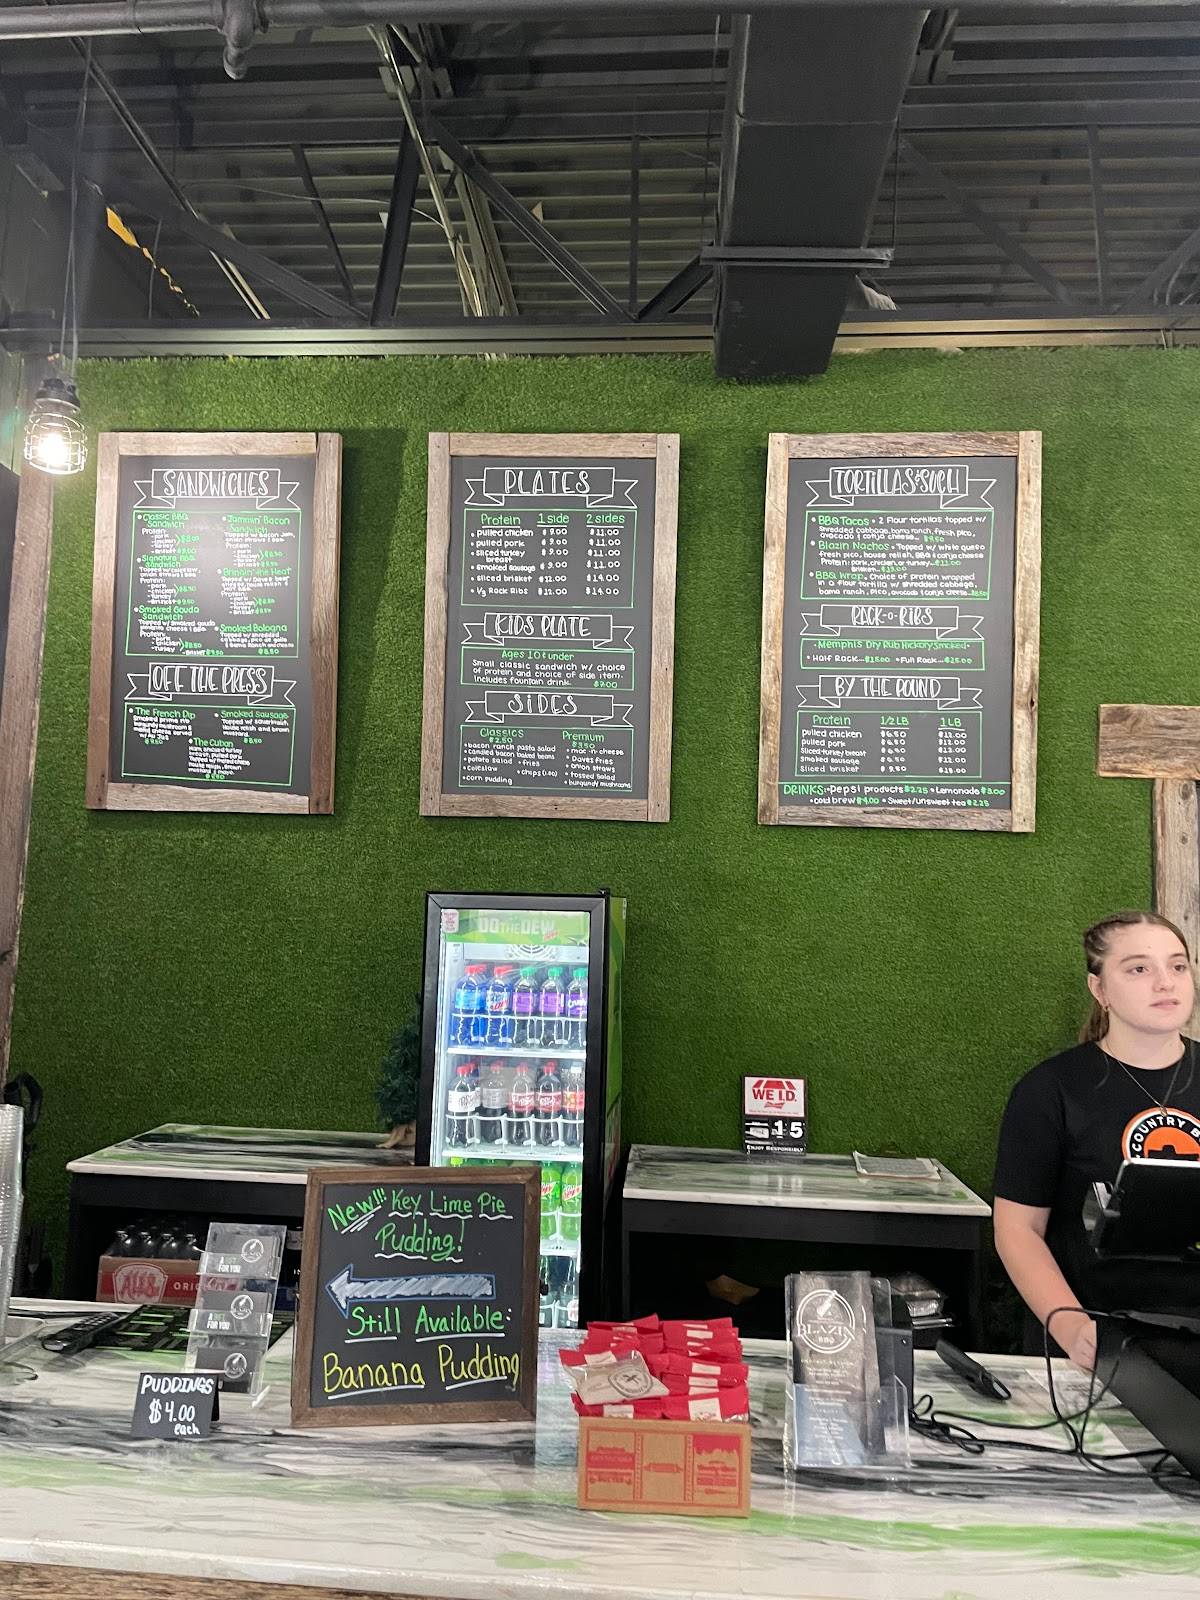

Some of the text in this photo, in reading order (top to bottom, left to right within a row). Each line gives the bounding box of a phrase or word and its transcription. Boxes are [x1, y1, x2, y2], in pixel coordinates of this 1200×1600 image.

[163, 470, 270, 496] SANDWICHES
[504, 470, 590, 494] PLATES
[264, 515, 290, 524] Bacon
[481, 513, 625, 525] Protein 1 side 2 sides
[818, 515, 839, 525] BBQ
[840, 516, 870, 526] Tacos
[945, 516, 972, 525] topped
[476, 529, 503, 538] pulled
[476, 538, 525, 548] pulled pork
[819, 541, 923, 551] Blazin Nachos Topped
[477, 574, 501, 582] sliced
[815, 571, 837, 580] BBQ
[139, 605, 200, 614] Smoked Gouda
[220, 624, 287, 632] Smoked Bologna
[495, 614, 592, 637] KIDS PLATE
[818, 640, 881, 650] Memphis Dry
[502, 650, 574, 660] Ages 10 under
[472, 659, 494, 667] Small
[500, 661, 530, 669] classic
[152, 666, 267, 694] OFF THE PRESS
[474, 675, 543, 685] Includes fountain
[835, 678, 941, 698] BY THE POUND
[508, 694, 578, 714] SIDES
[135, 707, 195, 719] The French Dip
[221, 710, 288, 719] Smoked Sausage
[812, 715, 961, 727] Protein 1/2 LB 1 LB
[480, 728, 524, 738] Classics
[563, 730, 605, 742] Premium
[802, 729, 862, 738] pulled chicken
[193, 737, 234, 748] The Cuban
[517, 744, 535, 752] pasta
[468, 756, 489, 764] potato
[522, 759, 540, 767] fries
[595, 757, 613, 765] fries
[593, 765, 615, 773] straws
[485, 776, 512, 785] pudding
[570, 771, 594, 779] tossed
[830, 785, 860, 796] Pepsi
[864, 786, 903, 795] products
[935, 786, 980, 795] Lemonade
[479, 918, 499, 933] DO
[752, 1089, 774, 1100] WE
[1132, 1116, 1186, 1152] COUNTRY
[392, 1188, 422, 1218] Key
[431, 1190, 473, 1213] Lime
[478, 1193, 506, 1213] Pie
[375, 1220, 465, 1261] Pudding!
[230, 1265, 241, 1273] YOU
[207, 1321, 230, 1330] FOR YOU
[347, 1304, 512, 1336] Still Available:
[323, 1343, 520, 1393] Banana Pudding
[141, 1375, 214, 1394] PUDDINGS
[149, 1399, 196, 1424] $4.00
[174, 1423, 200, 1435] each
